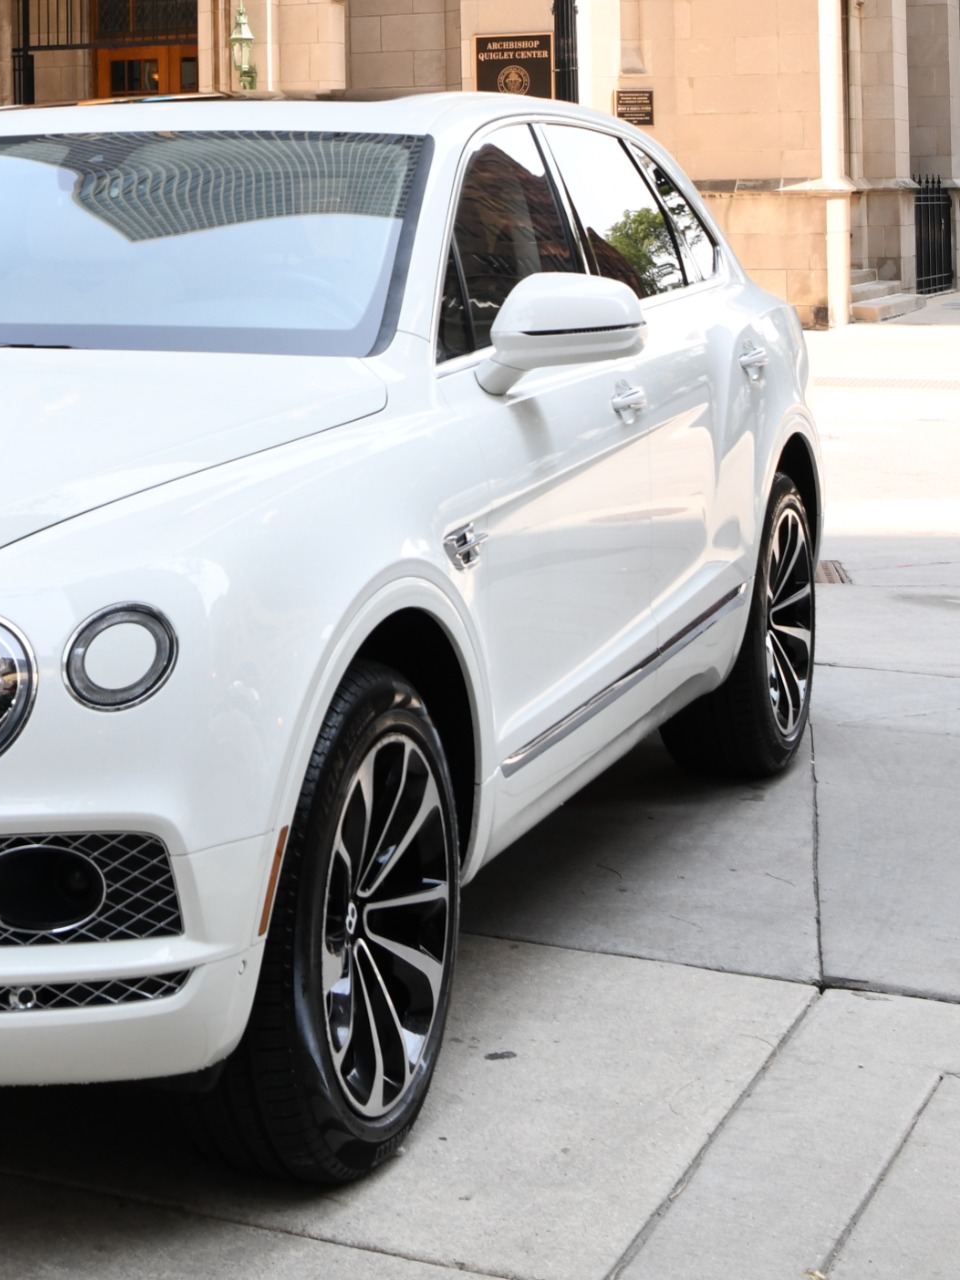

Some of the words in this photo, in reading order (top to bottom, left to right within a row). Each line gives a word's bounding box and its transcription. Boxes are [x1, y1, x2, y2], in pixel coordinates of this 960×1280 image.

[486, 40, 540, 50] ARCHBISHOP
[478, 51, 514, 61] QUIGLEY
[515, 50, 549, 59] CENTER
